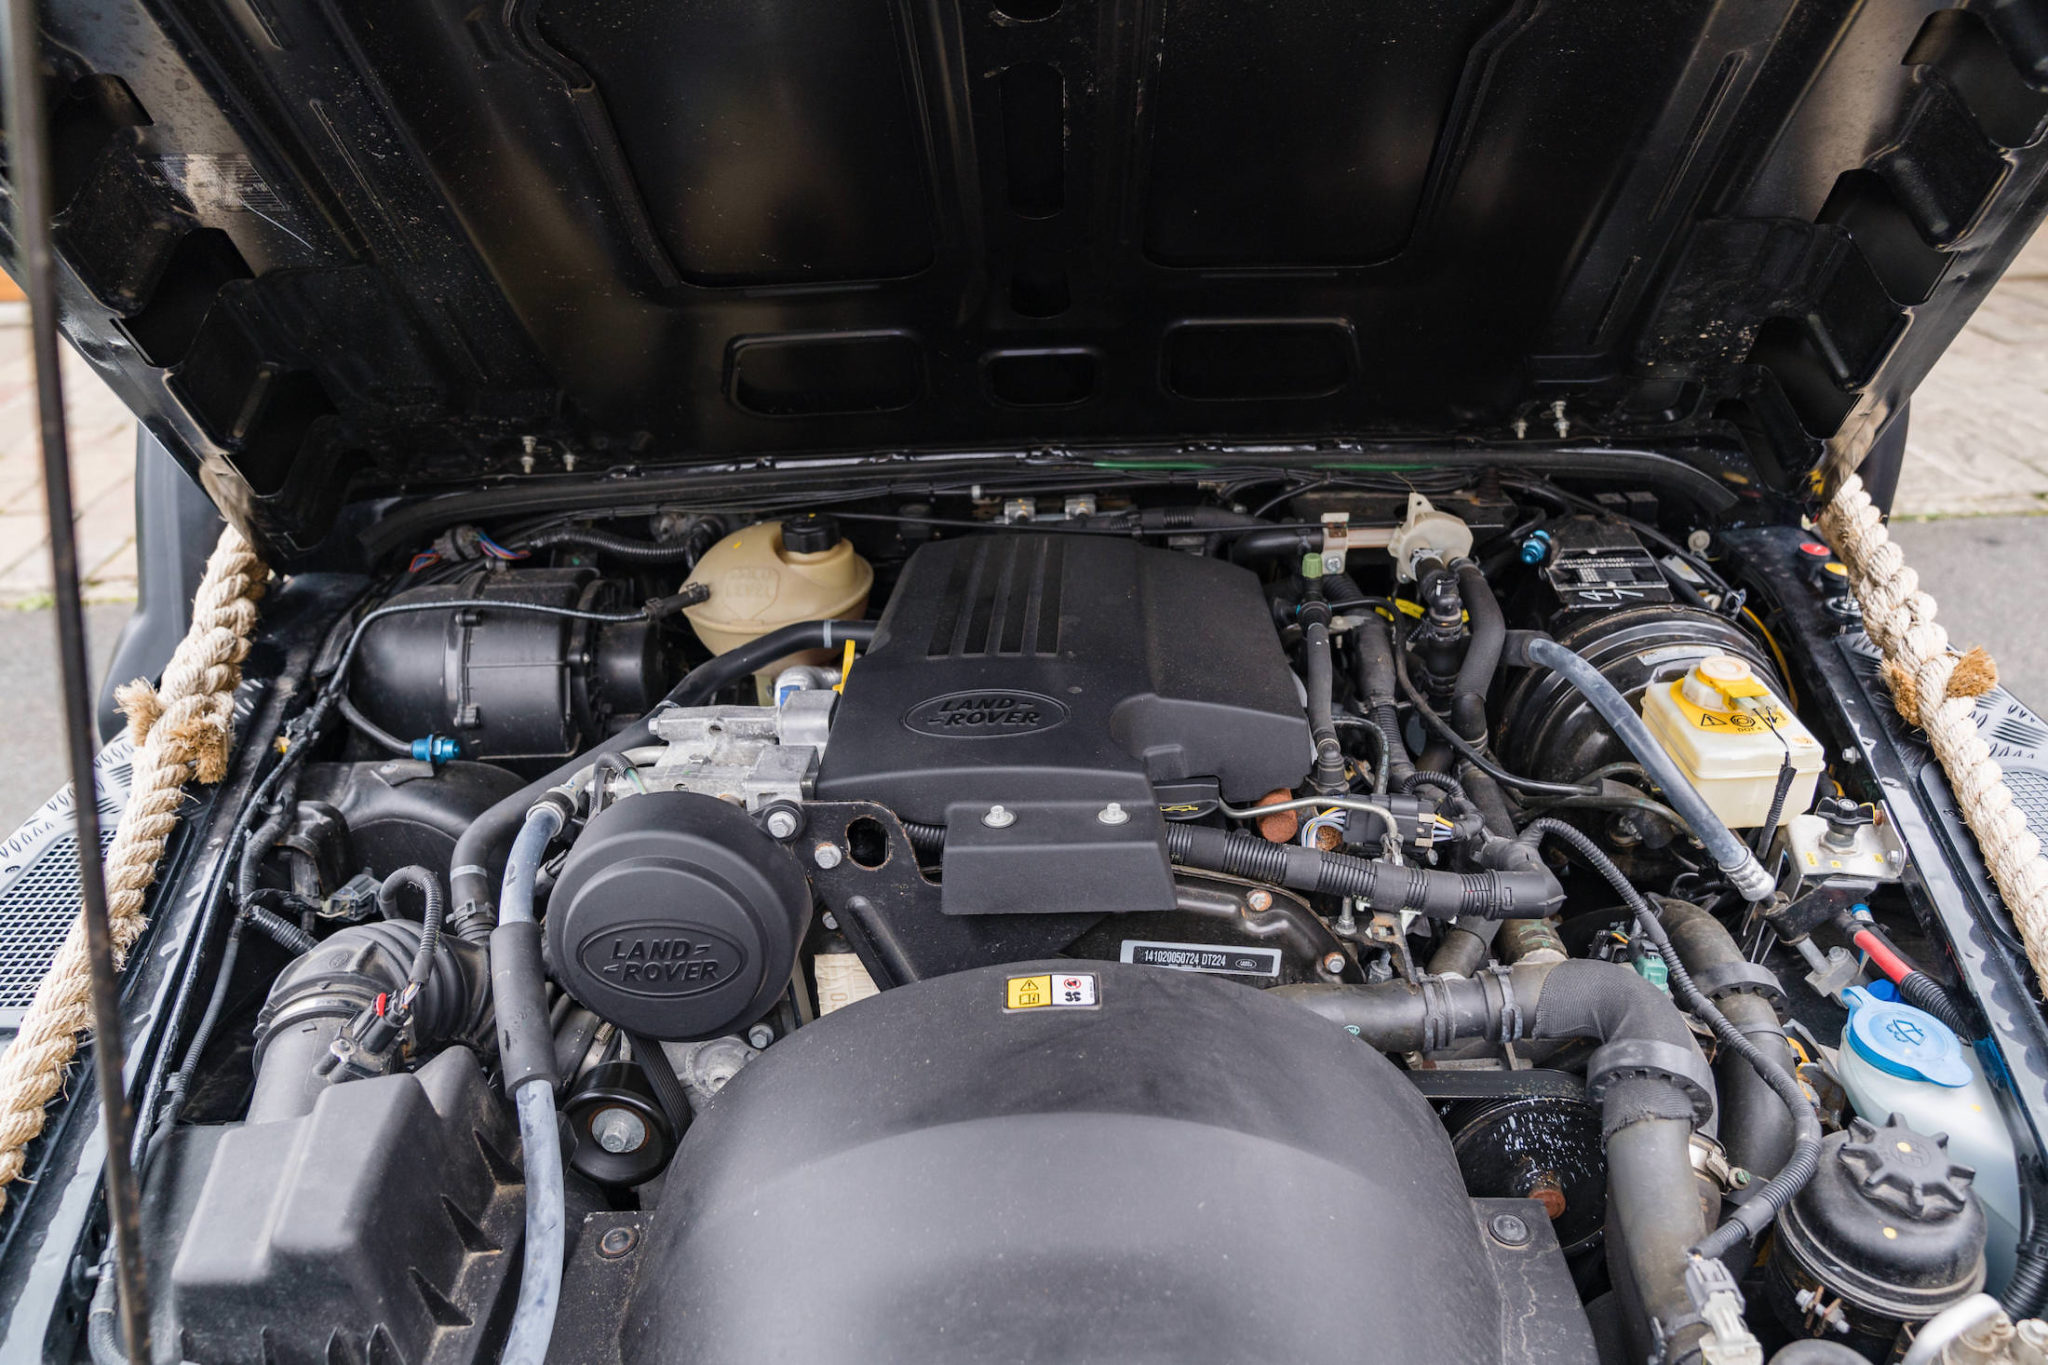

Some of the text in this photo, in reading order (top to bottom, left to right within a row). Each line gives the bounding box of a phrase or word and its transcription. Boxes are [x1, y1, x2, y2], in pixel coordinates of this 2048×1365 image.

[939, 697, 1017, 712] LAND
[943, 711, 1041, 727] ROVER
[610, 938, 692, 960] LAND
[1201, 953, 1227, 967] DT224
[620, 959, 720, 982] ROVER
